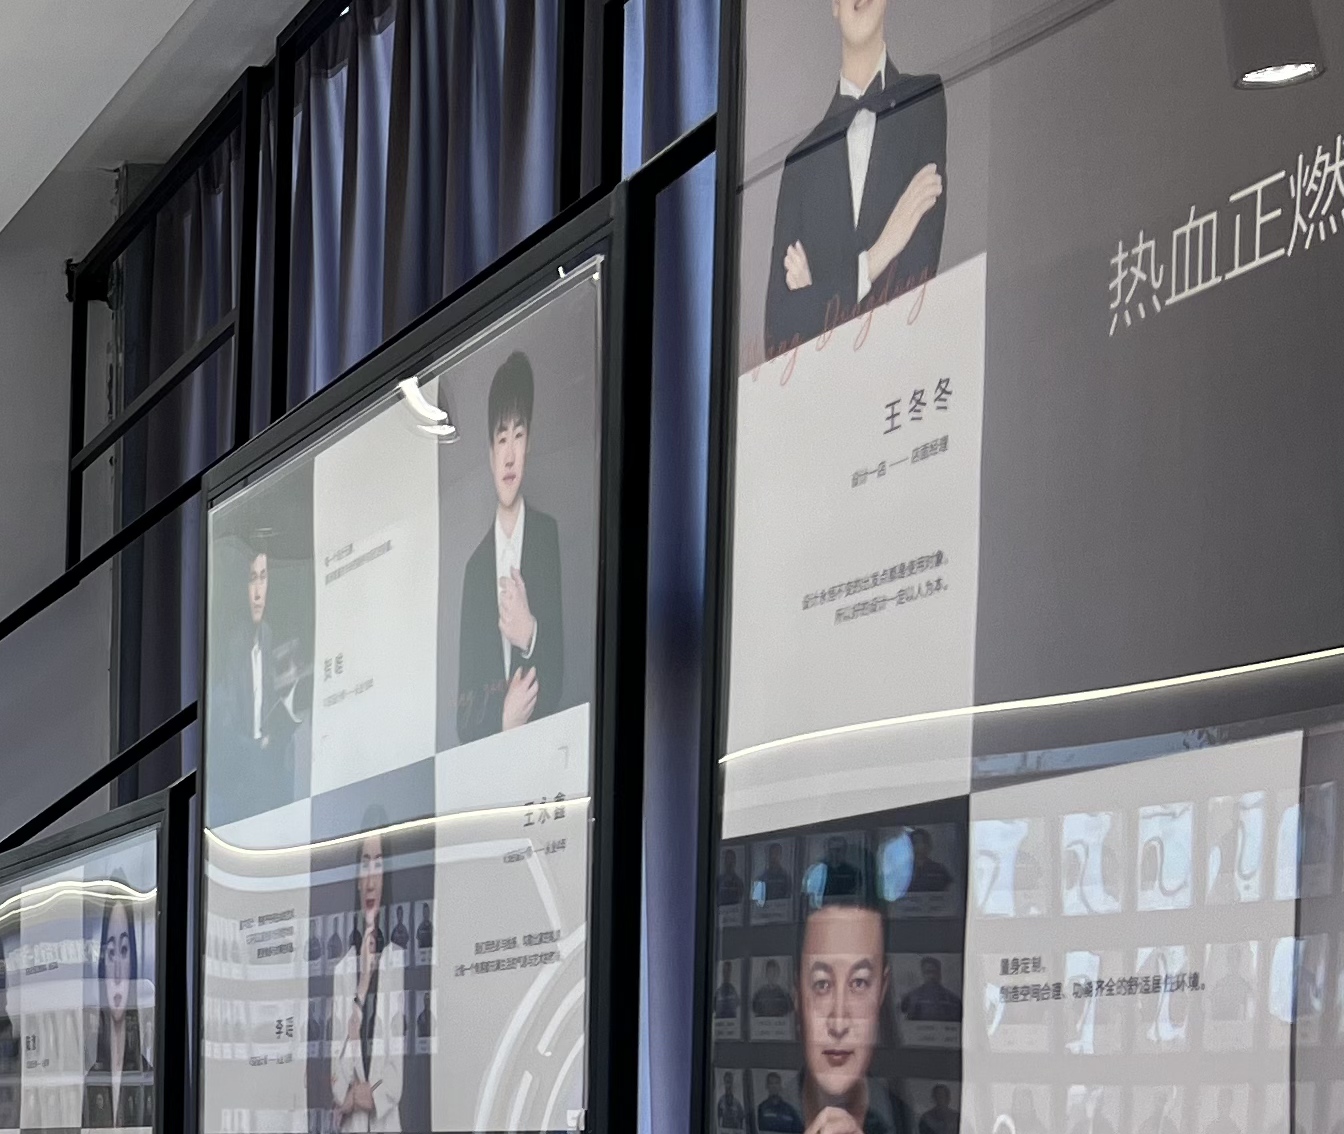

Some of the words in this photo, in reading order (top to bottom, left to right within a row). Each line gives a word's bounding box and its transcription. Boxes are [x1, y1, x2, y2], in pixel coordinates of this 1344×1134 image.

[1109, 134, 1344, 337] 热血正燃
[882, 377, 953, 435] 王冬冬
